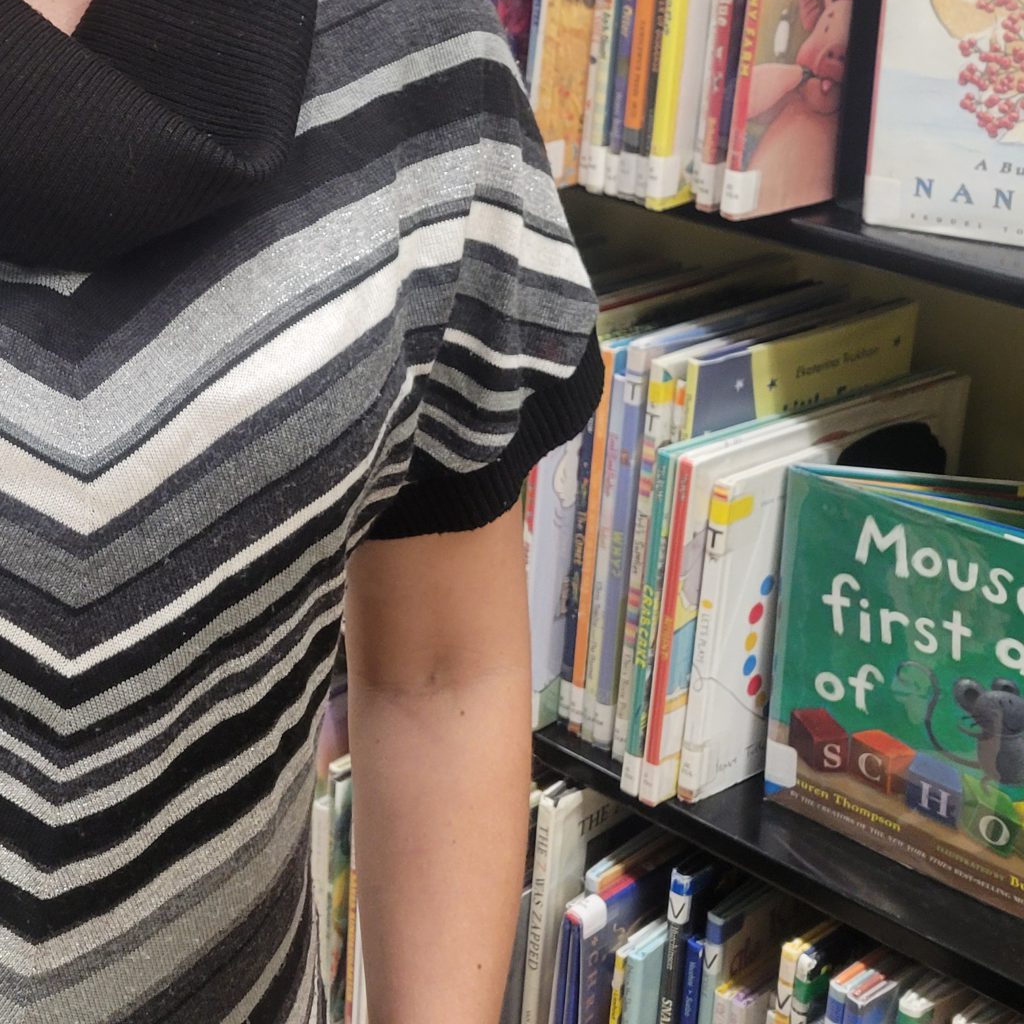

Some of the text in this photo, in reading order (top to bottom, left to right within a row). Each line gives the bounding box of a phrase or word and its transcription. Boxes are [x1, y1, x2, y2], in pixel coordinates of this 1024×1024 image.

[740, 26, 757, 77] FARM
[974, 159, 987, 171] A
[626, 381, 640, 401] T
[645, 411, 660, 432] T
[707, 526, 724, 549] T
[822, 573, 973, 662] first
[814, 663, 884, 714] of
[578, 803, 611, 838] THE
[833, 792, 901, 833] Thompson
[526, 826, 550, 972] THE Z WAS ZAPPED
[669, 897, 686, 919] V
